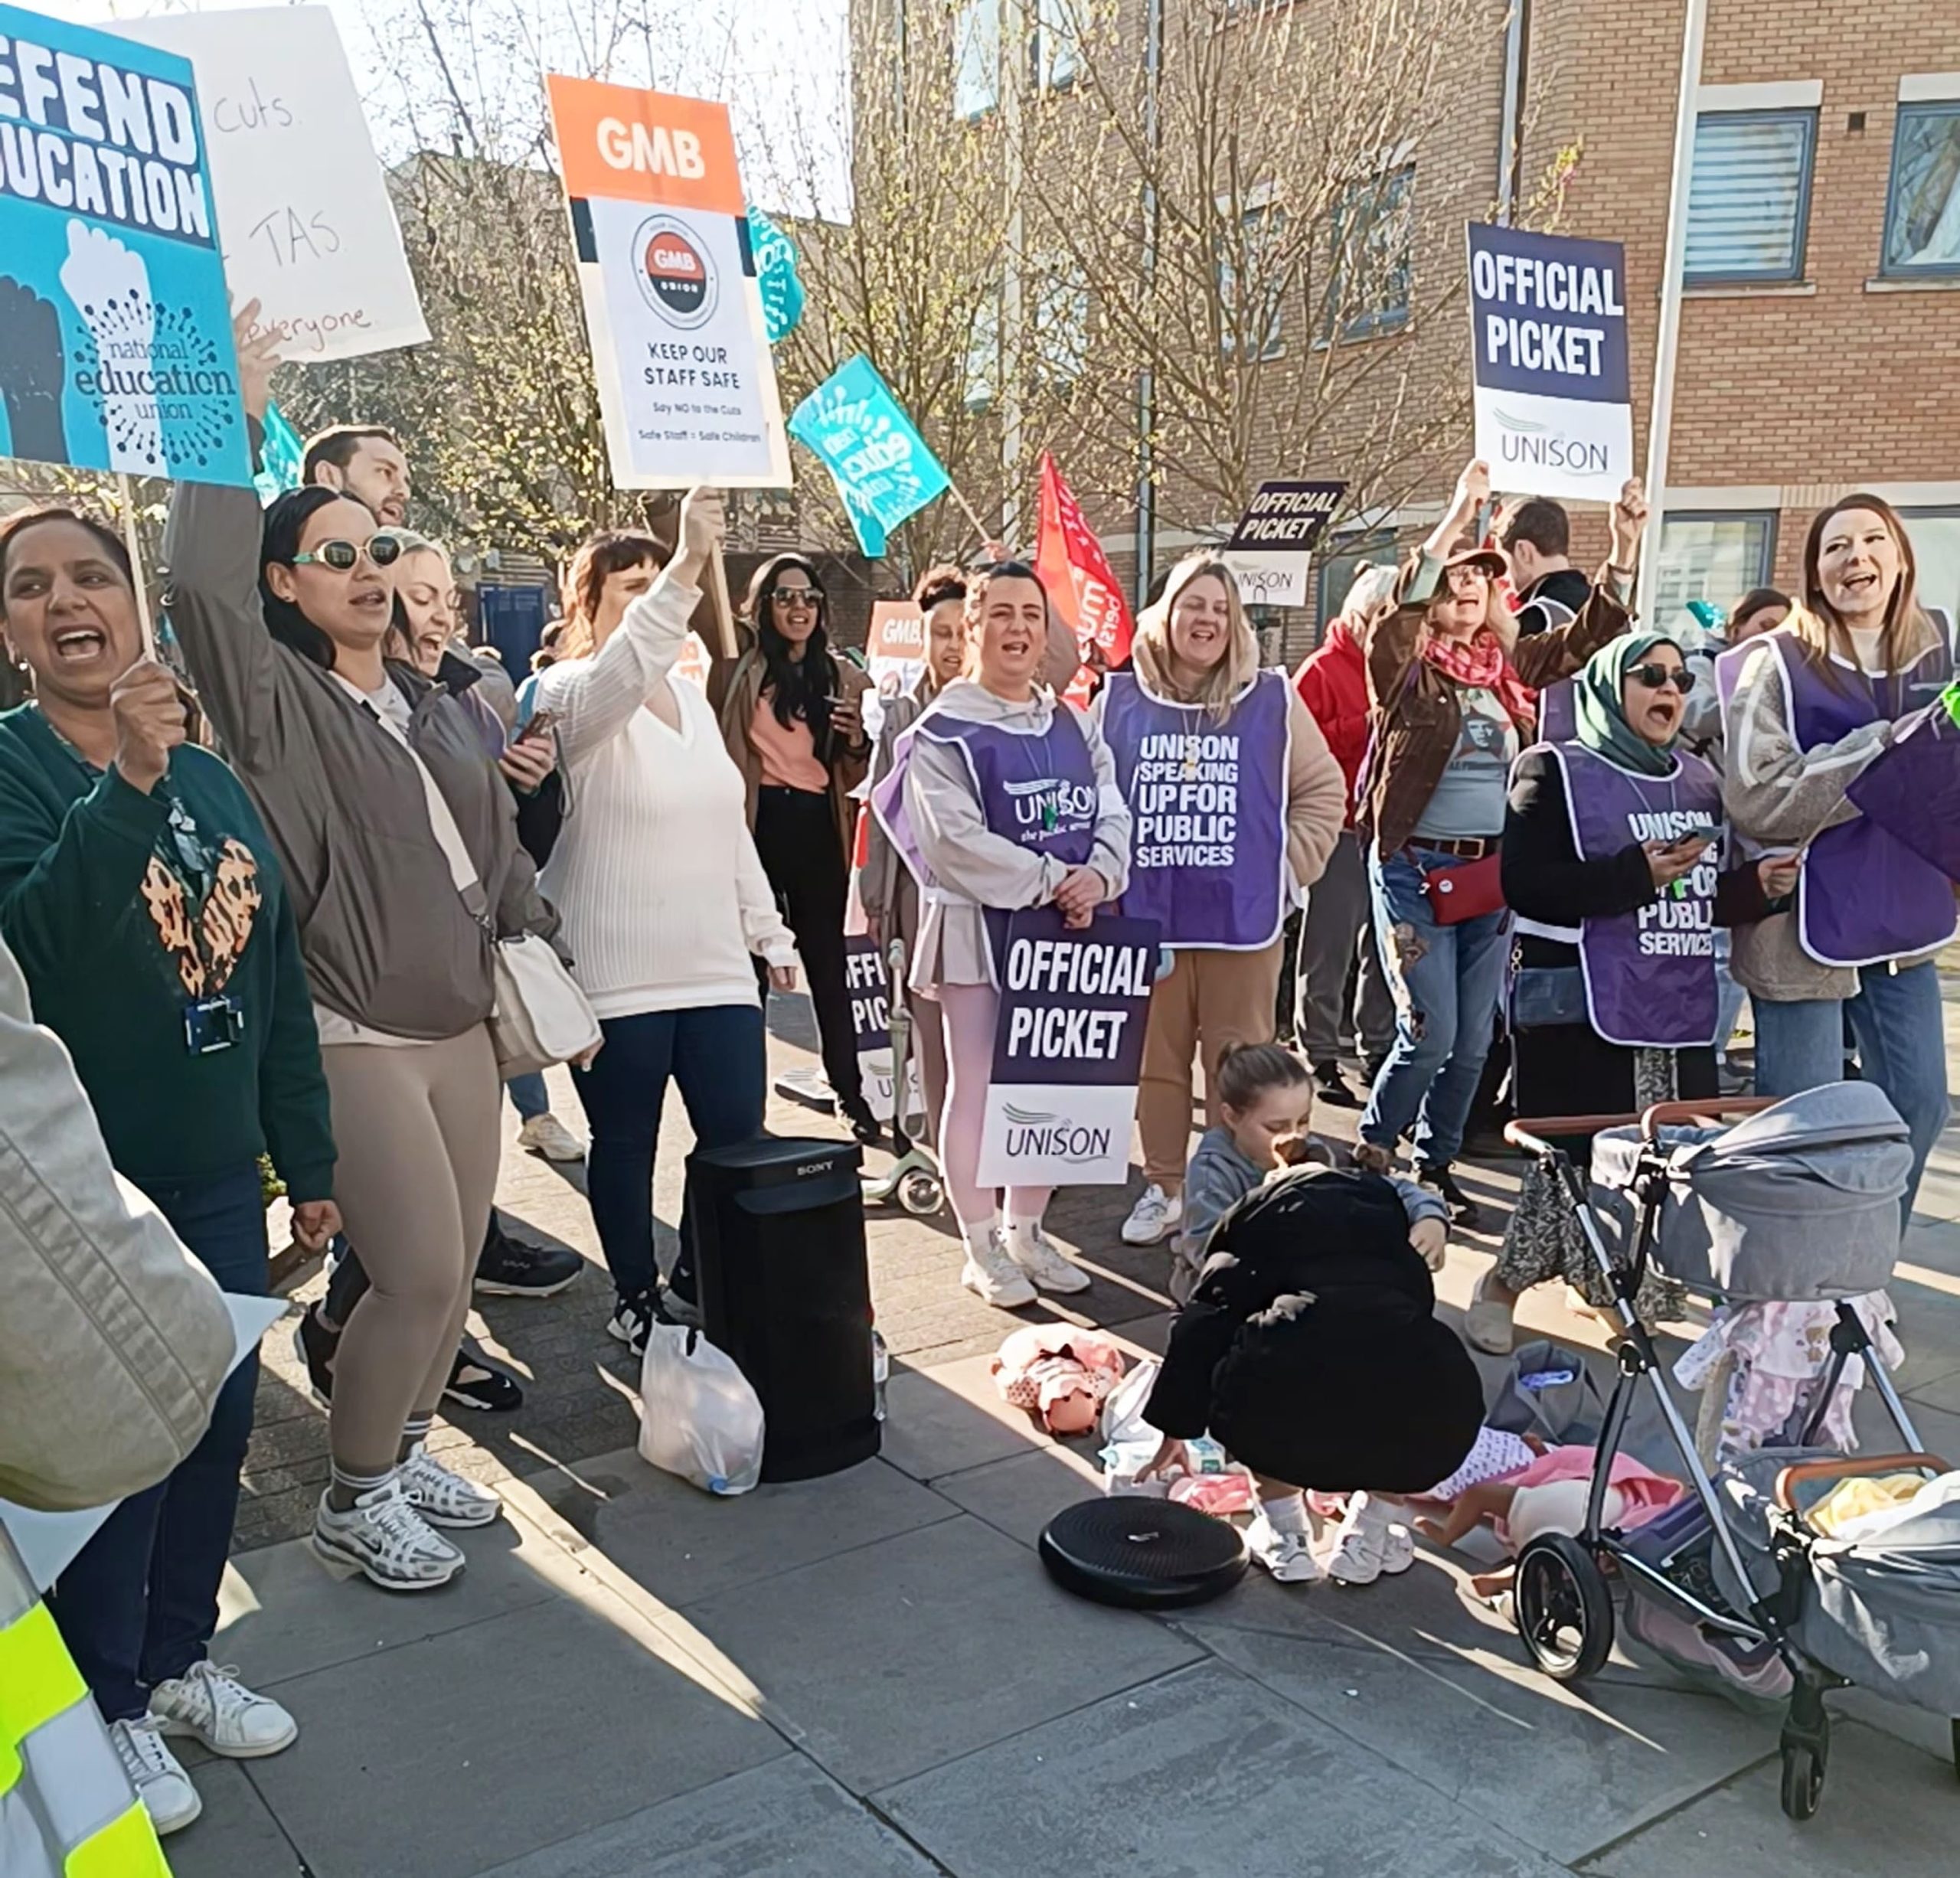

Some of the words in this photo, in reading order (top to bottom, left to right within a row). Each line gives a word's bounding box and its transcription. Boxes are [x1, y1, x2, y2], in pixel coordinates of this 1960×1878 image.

[596, 116, 705, 179] GMB
[0, 122, 210, 238] UCATION
[654, 249, 696, 271] GMB
[1473, 250, 1624, 316] OFFICIAL
[109, 338, 189, 359] national
[648, 342, 688, 361] KEEP
[692, 346, 727, 364] OUR
[1487, 315, 1604, 376] PICKET
[75, 360, 236, 395] education
[644, 367, 696, 386] STAFF
[701, 371, 740, 389] SAFE
[135, 399, 193, 420] union
[653, 402, 671, 415] Say
[1502, 434, 1608, 470] UNISON
[1250, 492, 1337, 514] OFFICIAL
[1240, 518, 1315, 541] PICKET
[1140, 733, 1240, 760] UNISON
[1138, 784, 1177, 814] UP
[1179, 782, 1237, 814] FOR
[1137, 815, 1236, 843] PUBLIC
[1136, 844, 1234, 867] SERVICES
[1008, 938, 1150, 996] OFFICIAL
[1008, 1007, 1128, 1059] PICKET
[1006, 1127, 1110, 1157] UNISON
[797, 1161, 834, 1175] SONY
